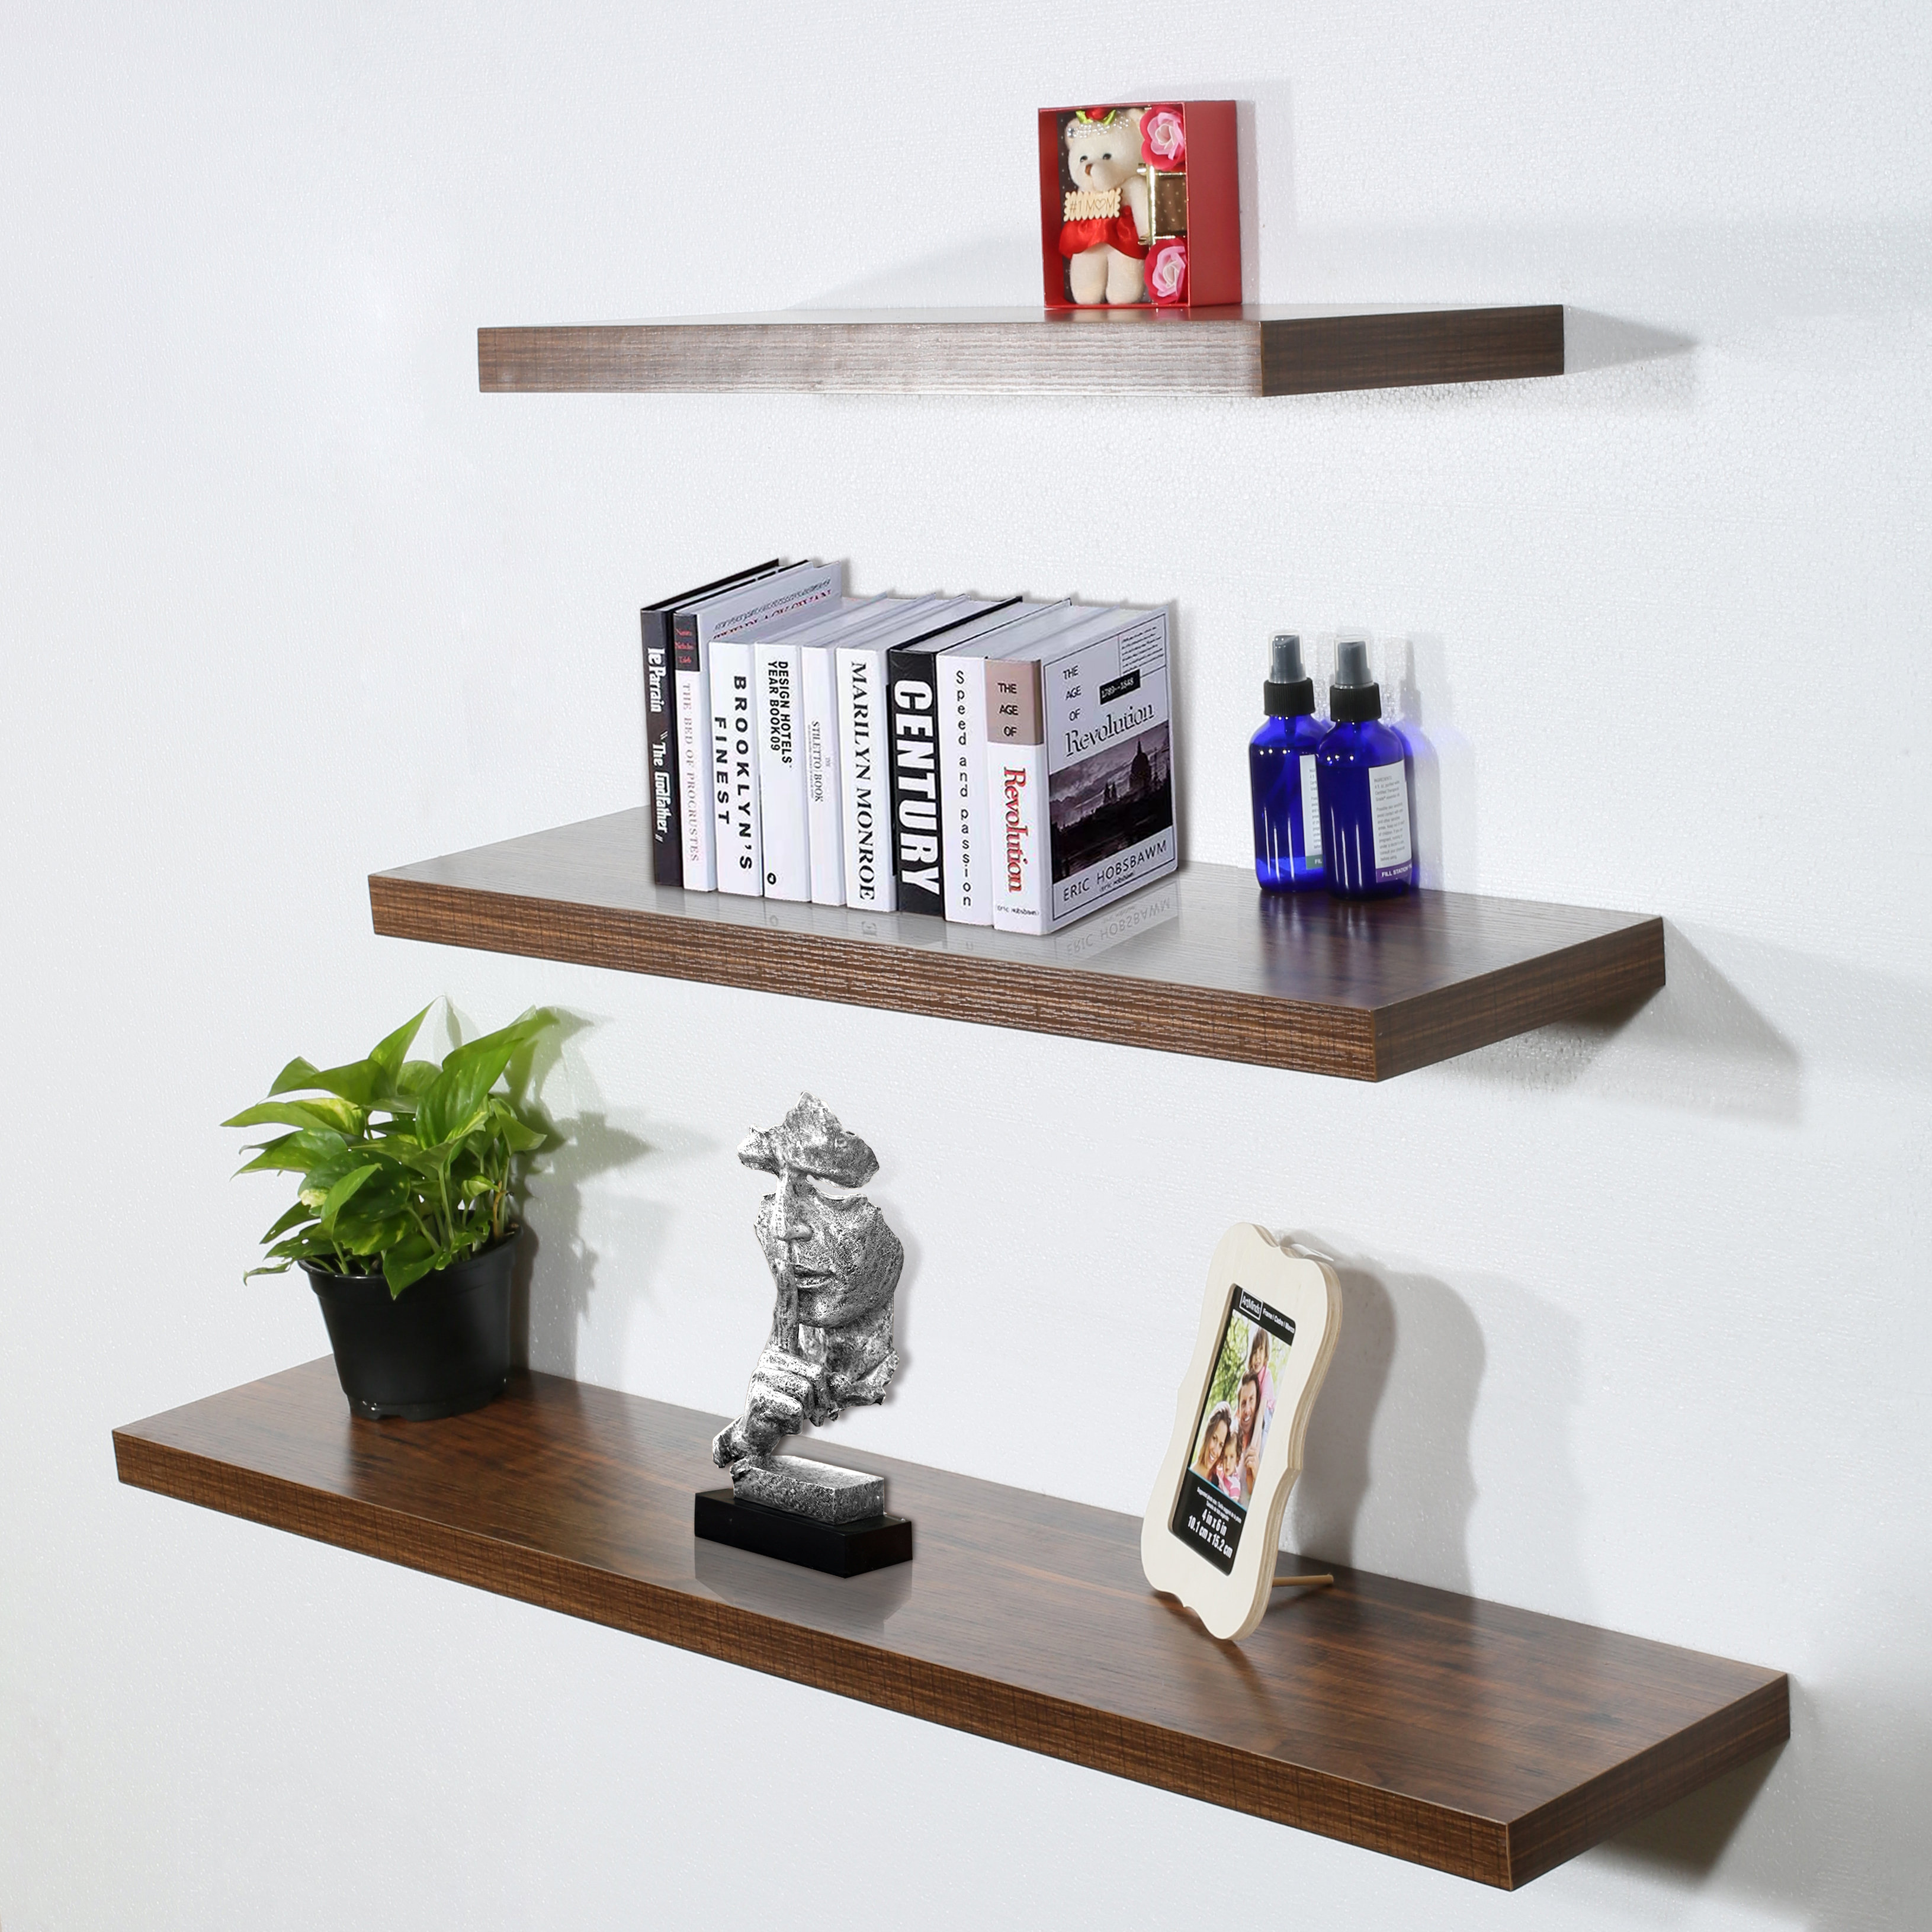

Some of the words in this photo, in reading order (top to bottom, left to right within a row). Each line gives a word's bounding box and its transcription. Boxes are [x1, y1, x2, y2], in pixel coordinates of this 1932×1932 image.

[1070, 201, 1081, 213] #1
[768, 660, 779, 694] YEAR
[778, 661, 790, 708] DESIGN
[997, 682, 1018, 694] THE
[1062, 665, 1079, 680] THE
[1065, 686, 1082, 701] AGE
[683, 683, 692, 710] THE
[955, 670, 967, 746] Speed
[999, 705, 1019, 715] AGE
[1068, 708, 1080, 722] OF
[684, 717, 694, 744] BED
[780, 714, 792, 763] HOTELS
[851, 662, 871, 781] MARILYN
[1003, 726, 1018, 737] OF
[1066, 704, 1154, 758] Revolution
[685, 749, 695, 768] OF
[714, 717, 730, 824] FINEST
[734, 675, 753, 870] BROOKLYN'S
[959, 756, 968, 798] and
[894, 679, 941, 895] CENTURY
[686, 772, 699, 862] PROCRUSTES
[1003, 766, 1029, 893] Revolution
[856, 788, 875, 900] MONROE
[960, 808, 971, 907] passion
[1063, 878, 1090, 901] ERIC
[1096, 839, 1167, 885] HOBSBAWM
[1188, 1515, 1201, 1533] 10.1
[1199, 1526, 1209, 1540] cm
[1206, 1532, 1213, 1543] x
[1211, 1533, 1225, 1552] 15.2
[1223, 1545, 1233, 1559] cm
[1202, 1509, 1208, 1521] 4
[1206, 1511, 1213, 1526] in
[1211, 1519, 1217, 1529] x
[1215, 1519, 1222, 1532] 6
[1219, 1522, 1227, 1536] in
